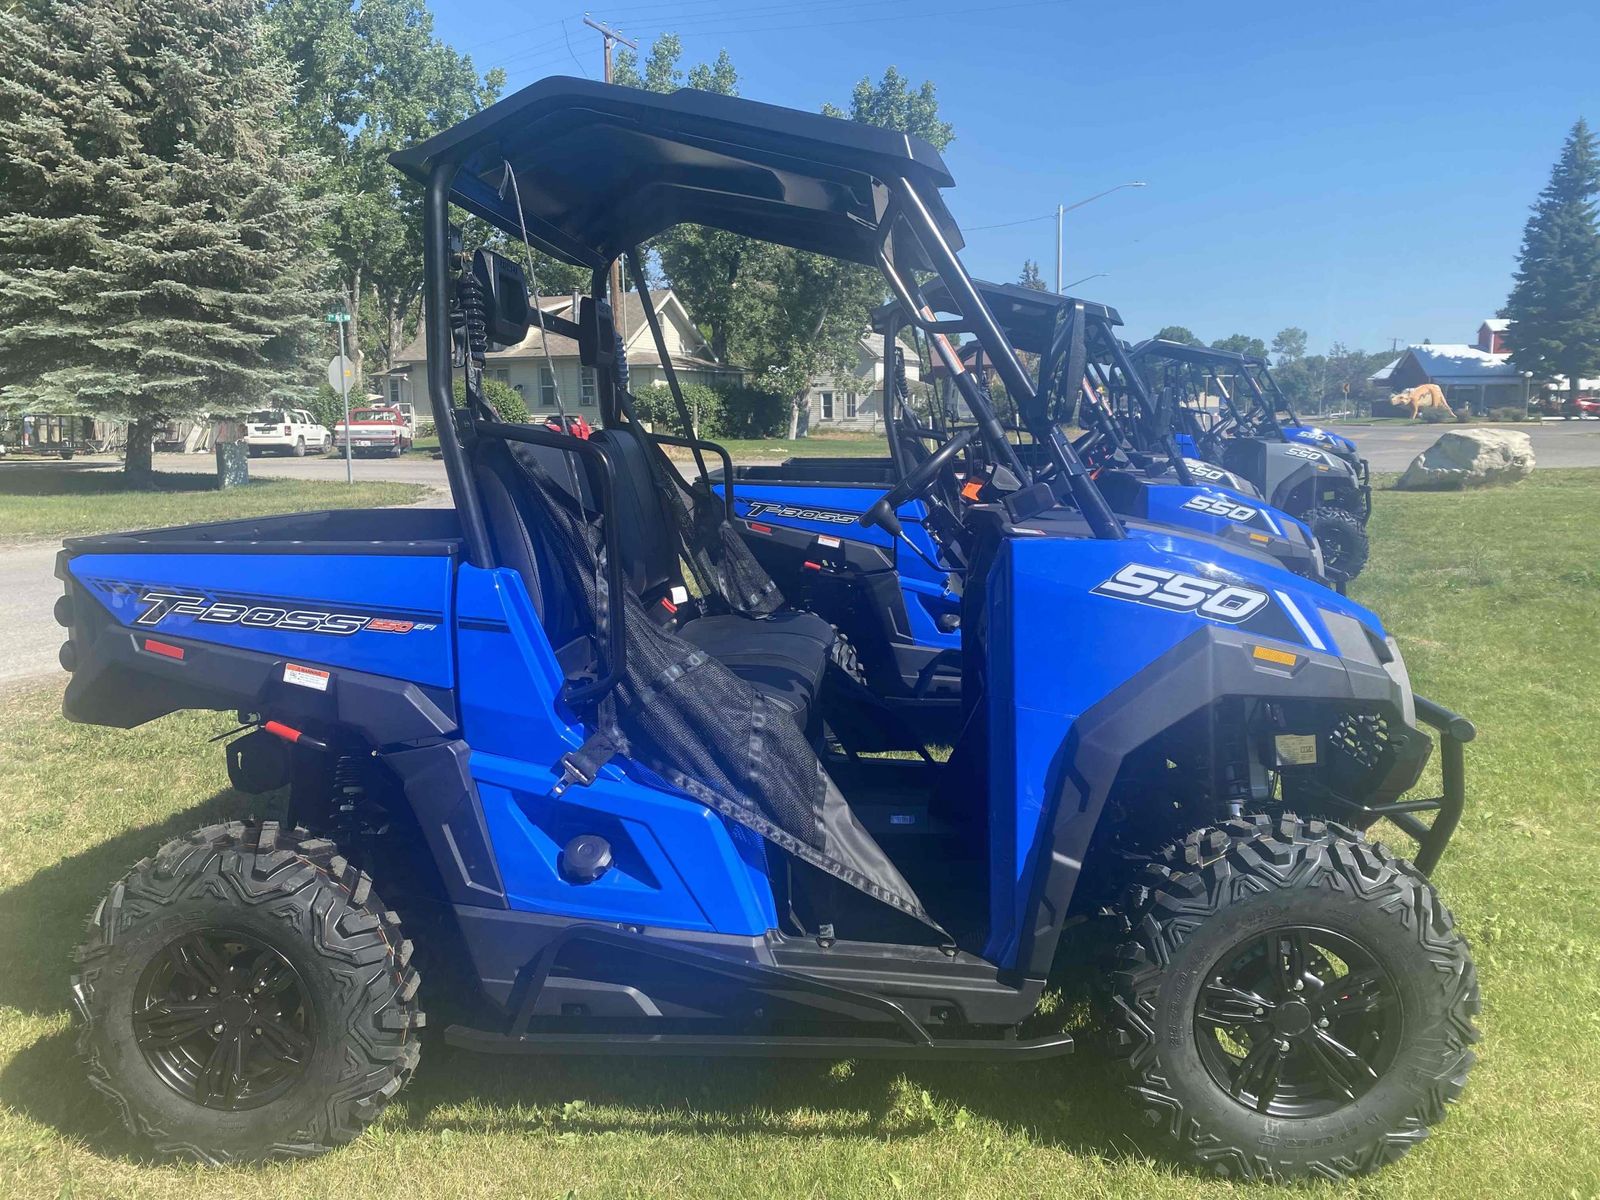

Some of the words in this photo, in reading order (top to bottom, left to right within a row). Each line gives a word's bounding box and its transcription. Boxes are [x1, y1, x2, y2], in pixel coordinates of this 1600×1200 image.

[1283, 448, 1321, 461] 550
[747, 501, 860, 525] T-BOSS
[1180, 495, 1258, 523] 550
[1093, 562, 1269, 622] 550
[137, 592, 370, 635] T-BOSS
[363, 617, 414, 634] 550
[413, 623, 438, 631] EFI
